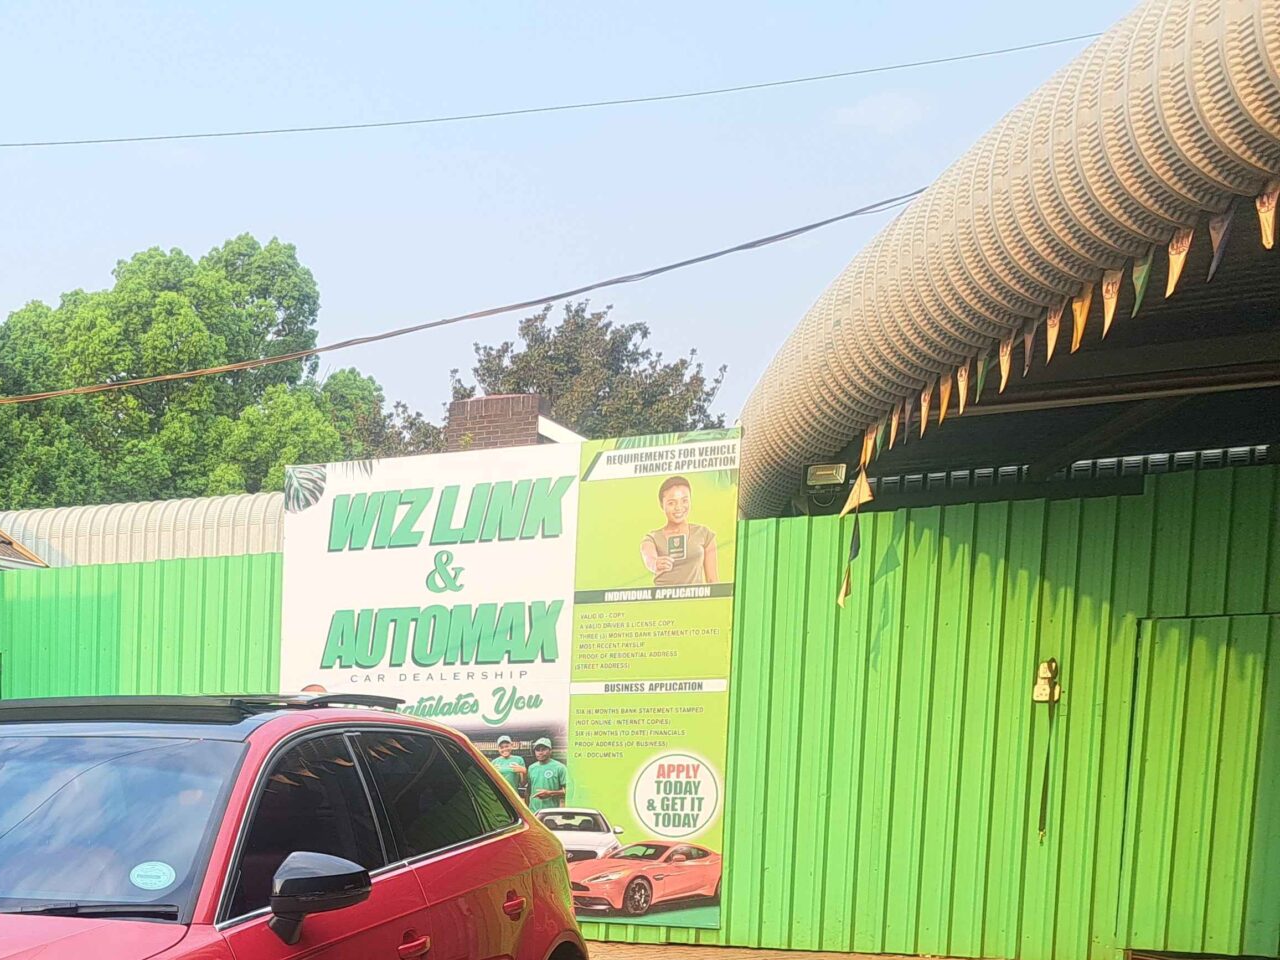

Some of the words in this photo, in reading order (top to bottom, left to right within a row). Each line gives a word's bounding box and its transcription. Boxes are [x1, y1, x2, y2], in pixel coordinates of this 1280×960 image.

[606, 449, 676, 465] REQUIREMENTS
[678, 447, 696, 459] FOR
[698, 443, 737, 457] VEHICLE
[634, 461, 672, 474] FINANCE
[674, 456, 736, 471] APPLICATION
[327, 487, 434, 552] WIZ
[429, 475, 577, 546] LINK
[425, 550, 465, 593] &
[604, 590, 652, 602] INDIVIDUAL
[655, 586, 711, 599] APPLICATION
[319, 599, 565, 669] AUTOMAX
[350, 673, 385, 683] CAR
[399, 670, 528, 682] DEALERSHIP
[604, 683, 645, 693] BUSINESS
[648, 681, 703, 692] APPLICATION
[482, 685, 543, 725] You
[656, 764, 700, 779] APPLY
[654, 780, 701, 795] TODAY
[646, 798, 657, 811] &
[660, 796, 687, 812] GET
[690, 797, 704, 812] IT
[653, 812, 700, 828] TODAY
